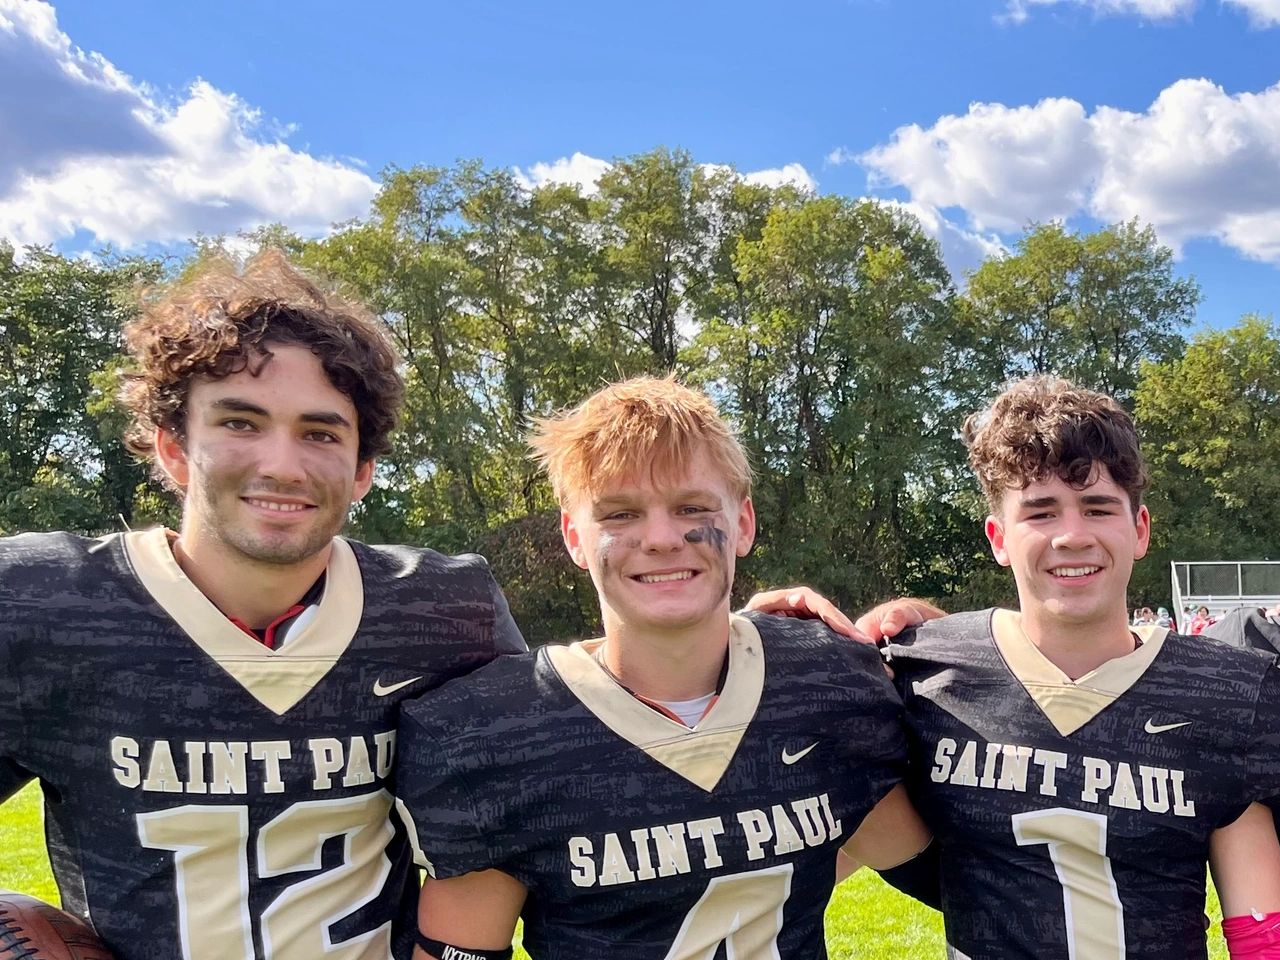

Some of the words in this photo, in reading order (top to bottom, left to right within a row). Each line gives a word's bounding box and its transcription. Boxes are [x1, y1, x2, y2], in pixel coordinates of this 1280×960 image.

[111, 735, 291, 795] SAINT
[309, 729, 397, 790] PAU
[930, 737, 1068, 797] SAINT
[1081, 756, 1196, 817] PAUL
[568, 816, 725, 888] SAINT
[736, 793, 844, 862] PAUL
